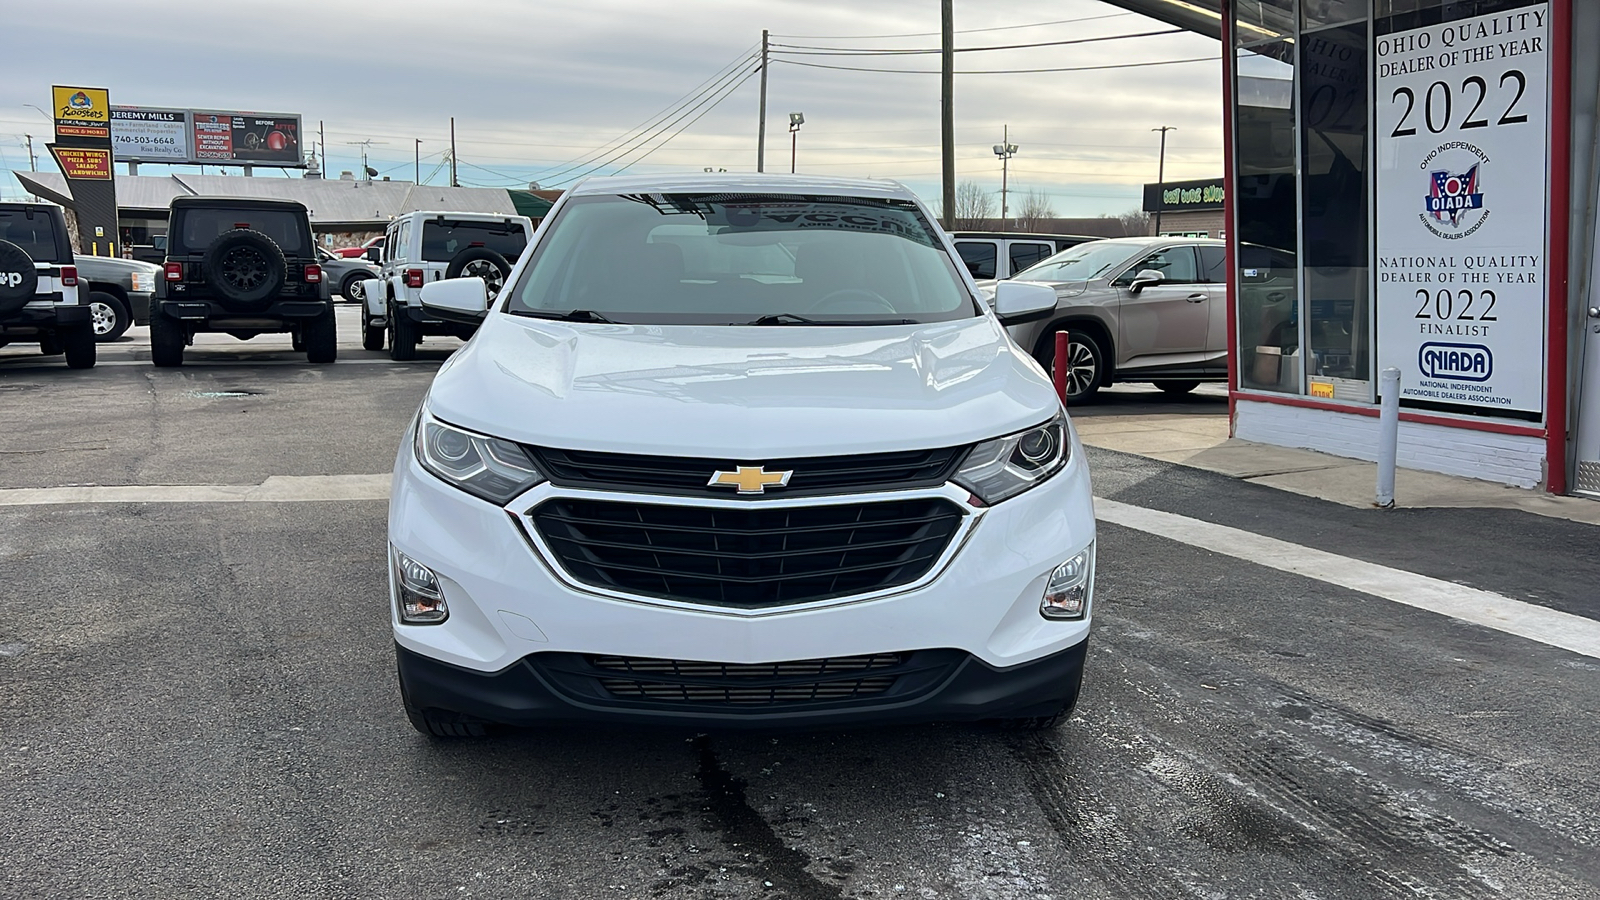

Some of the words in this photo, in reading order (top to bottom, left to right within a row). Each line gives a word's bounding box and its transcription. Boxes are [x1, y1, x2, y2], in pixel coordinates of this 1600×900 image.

[1378, 33, 1431, 57] OHIO
[1441, 9, 1546, 47] QUALITY
[1380, 55, 1435, 78] DEALER
[1439, 51, 1458, 68] OF
[1463, 45, 1494, 64] THE
[1499, 37, 1543, 58] YEAR
[1391, 69, 1528, 137] 2022
[59, 105, 104, 119] Roosters
[111, 111, 146, 120] JEREMY
[148, 113, 175, 121] MILLS
[114, 136, 175, 144] 740-503-6648
[154, 147, 172, 155] Realty
[1420, 150, 1437, 170] OHIO
[1438, 141, 1490, 164] INDEPENDENT
[1432, 195, 1473, 211] OIADA
[1419, 213, 1442, 239] AUTOMOBILE
[1442, 231, 1464, 240] DEALERS
[1464, 209, 1490, 238] ASSOCIATION
[1380, 256, 1457, 268] NATIONAL
[1464, 255, 1539, 270] QUALITY
[1381, 272, 1432, 283] DEALER
[1438, 272, 1455, 283] OF
[1462, 272, 1490, 283] THE
[1497, 272, 1536, 283] YEAR
[1415, 288, 1498, 321] 2022
[1420, 323, 1490, 337] FINALIST
[1424, 349, 1485, 375] NIADA
[1419, 380, 1449, 390] NATIONAL
[1450, 383, 1493, 394] INDEPENDENT
[1403, 388, 1440, 399] AUTOMOBILE
[1441, 391, 1467, 401] DEALERS
[1468, 394, 1512, 405] ASSOCIATION
